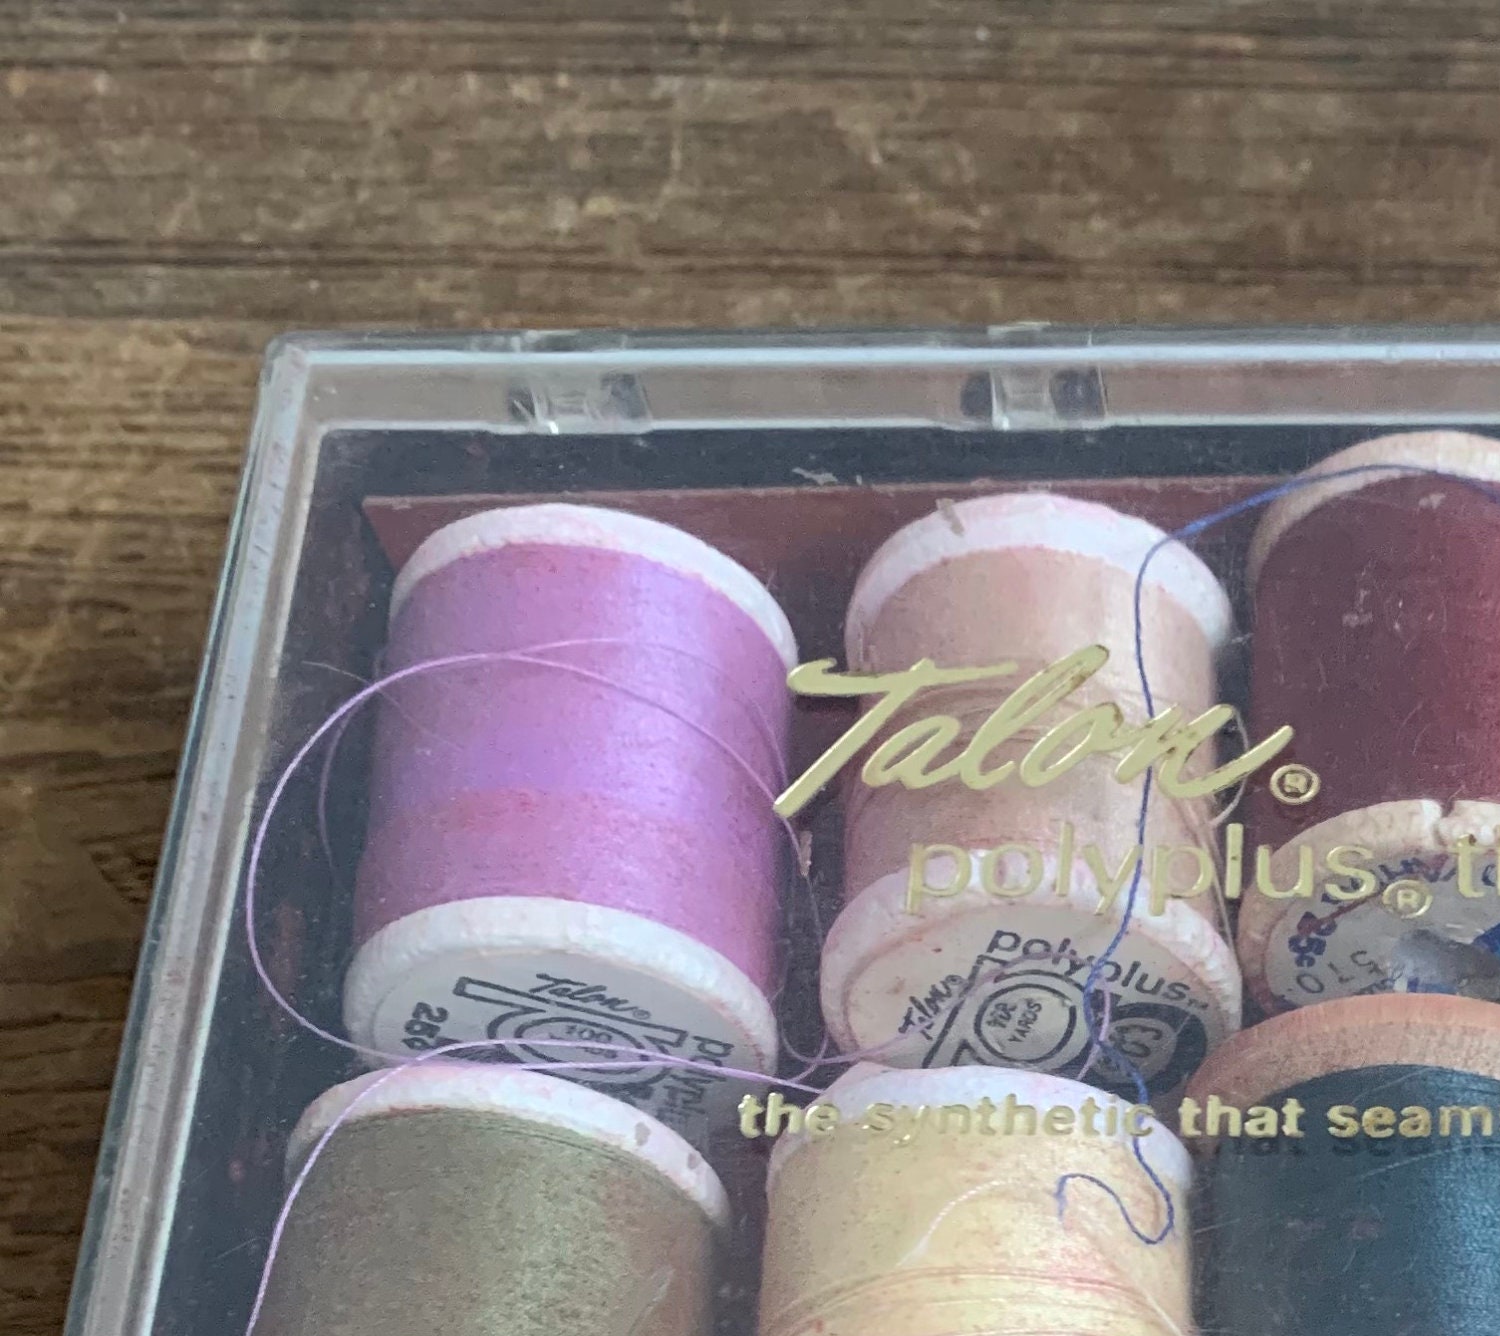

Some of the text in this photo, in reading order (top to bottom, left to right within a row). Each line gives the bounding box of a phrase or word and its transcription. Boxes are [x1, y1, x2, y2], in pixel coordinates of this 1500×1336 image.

[738, 1092, 834, 1139] the
[868, 1092, 1155, 1143] synthetic
[1179, 1093, 1305, 1139] that
